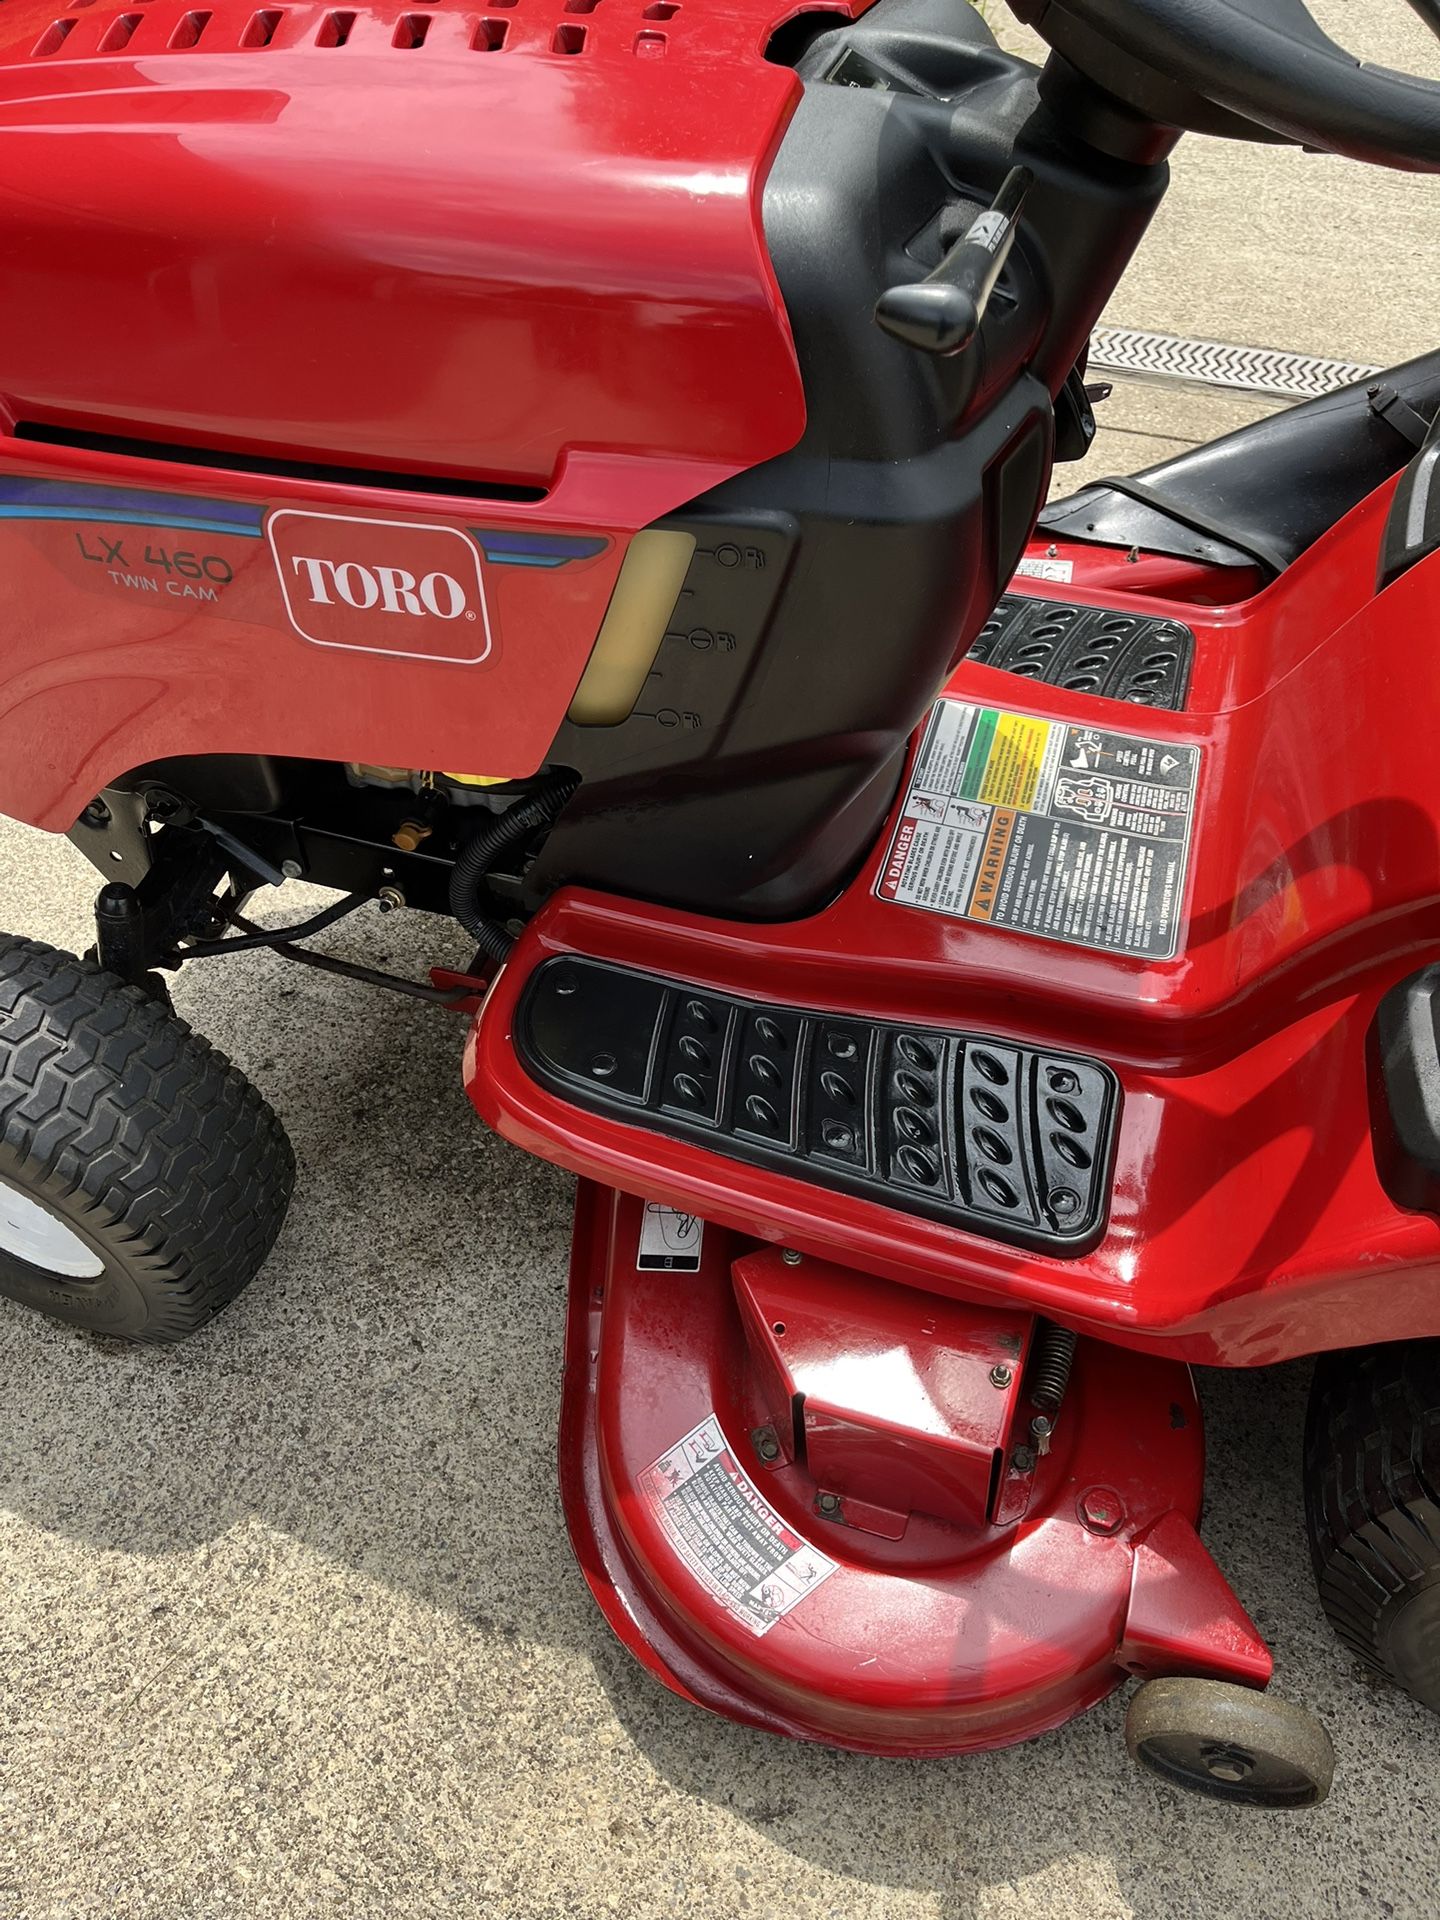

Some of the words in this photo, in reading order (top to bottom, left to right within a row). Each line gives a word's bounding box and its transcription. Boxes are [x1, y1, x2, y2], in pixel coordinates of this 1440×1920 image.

[76, 532, 128, 567] LX
[145, 546, 233, 586] 460
[107, 570, 159, 593] TWIN
[166, 581, 218, 602] CAM
[292, 556, 466, 620] TORO
[1016, 815, 1028, 835] DEATH
[912, 831, 922, 847] CAUSE
[917, 846, 925, 854] OR
[919, 830, 929, 847] DEATH
[1013, 834, 1023, 844] OR
[887, 824, 915, 878] DANGER
[907, 846, 918, 864] BLADES
[912, 853, 923, 871] INJURY
[978, 815, 1009, 894] WARNING
[1008, 843, 1021, 866] INJURY
[900, 864, 912, 888] ROTATING
[906, 870, 918, 891] SERIOUS
[1002, 865, 1016, 892] SERIOUS
[1165, 859, 1176, 884] MANUAL
[997, 891, 1009, 911] AVOID
[1159, 883, 1173, 919] OPERATOR'S
[995, 911, 1005, 921] TO
[1157, 918, 1168, 935] READ
[702, 1471, 724, 1502] ROTATING
[720, 1500, 737, 1521] PARTS
[712, 1461, 728, 1483] AVOID
[723, 1480, 745, 1509] SERIOUS
[741, 1505, 763, 1529] INJURY
[758, 1526, 771, 1538] OR
[767, 1534, 788, 1555] DEATH
[736, 1479, 784, 1535] DANGER
[707, 1468, 720, 1485] KEEP
[716, 1483, 733, 1506] HANDS
[730, 1503, 743, 1518] AND
[739, 1515, 754, 1532] FEET
[751, 1529, 768, 1547] AWAY
[765, 1544, 784, 1561] FROM
